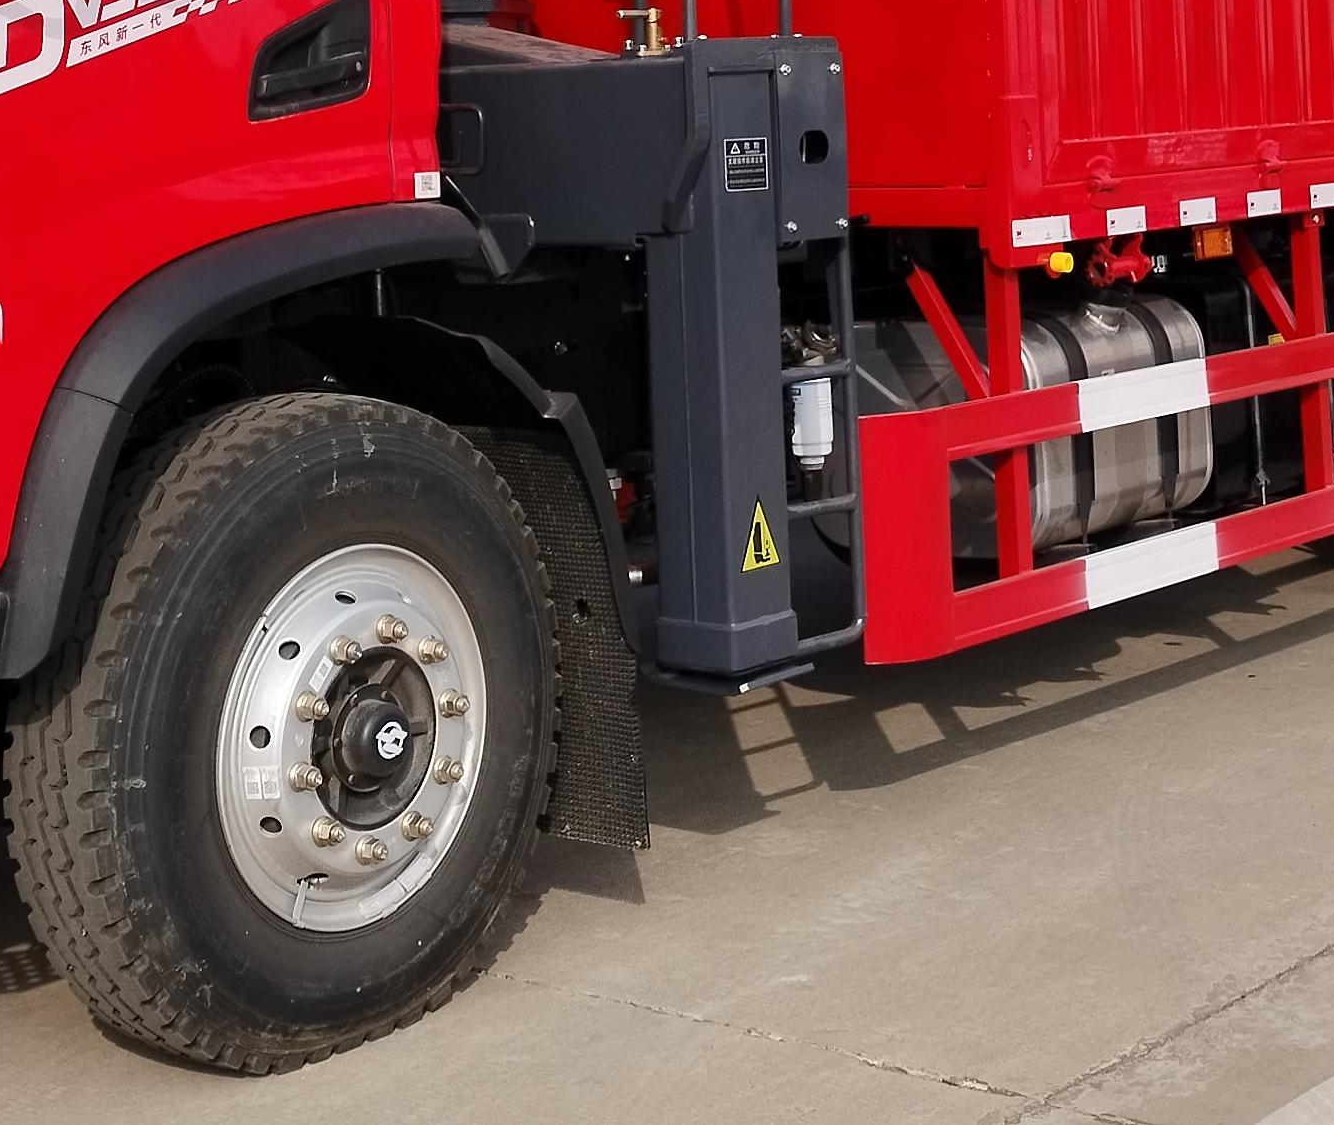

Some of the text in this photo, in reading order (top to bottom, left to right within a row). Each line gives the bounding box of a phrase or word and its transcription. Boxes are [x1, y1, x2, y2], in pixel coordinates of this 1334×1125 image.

[79, 13, 162, 56] 东风新一代
